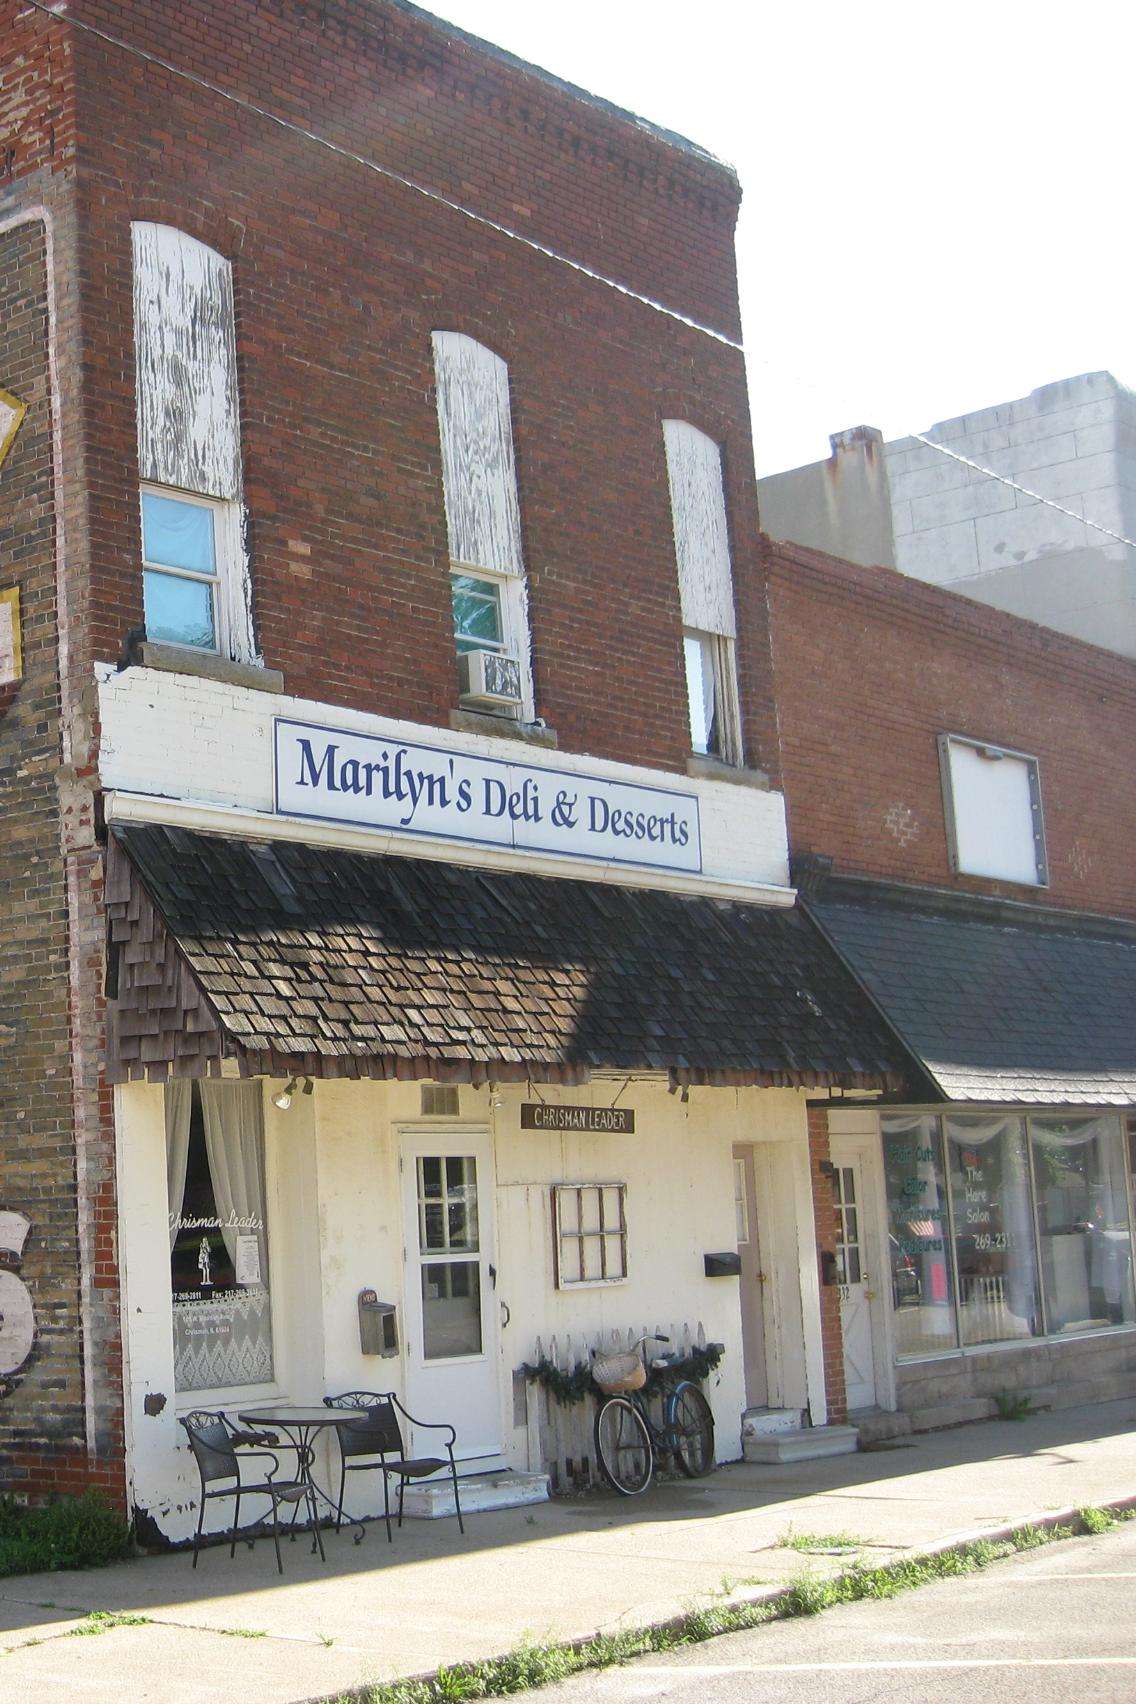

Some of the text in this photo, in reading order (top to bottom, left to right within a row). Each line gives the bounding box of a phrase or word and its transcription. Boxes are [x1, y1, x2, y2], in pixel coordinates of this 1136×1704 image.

[295, 738, 690, 847] Marilyn's Deli & Desserts
[534, 1107, 626, 1130] CHRISMAN LEADER
[966, 1167, 983, 1181] The
[168, 1208, 264, 1230] Chrisman Leader
[966, 1208, 990, 1223] Salon
